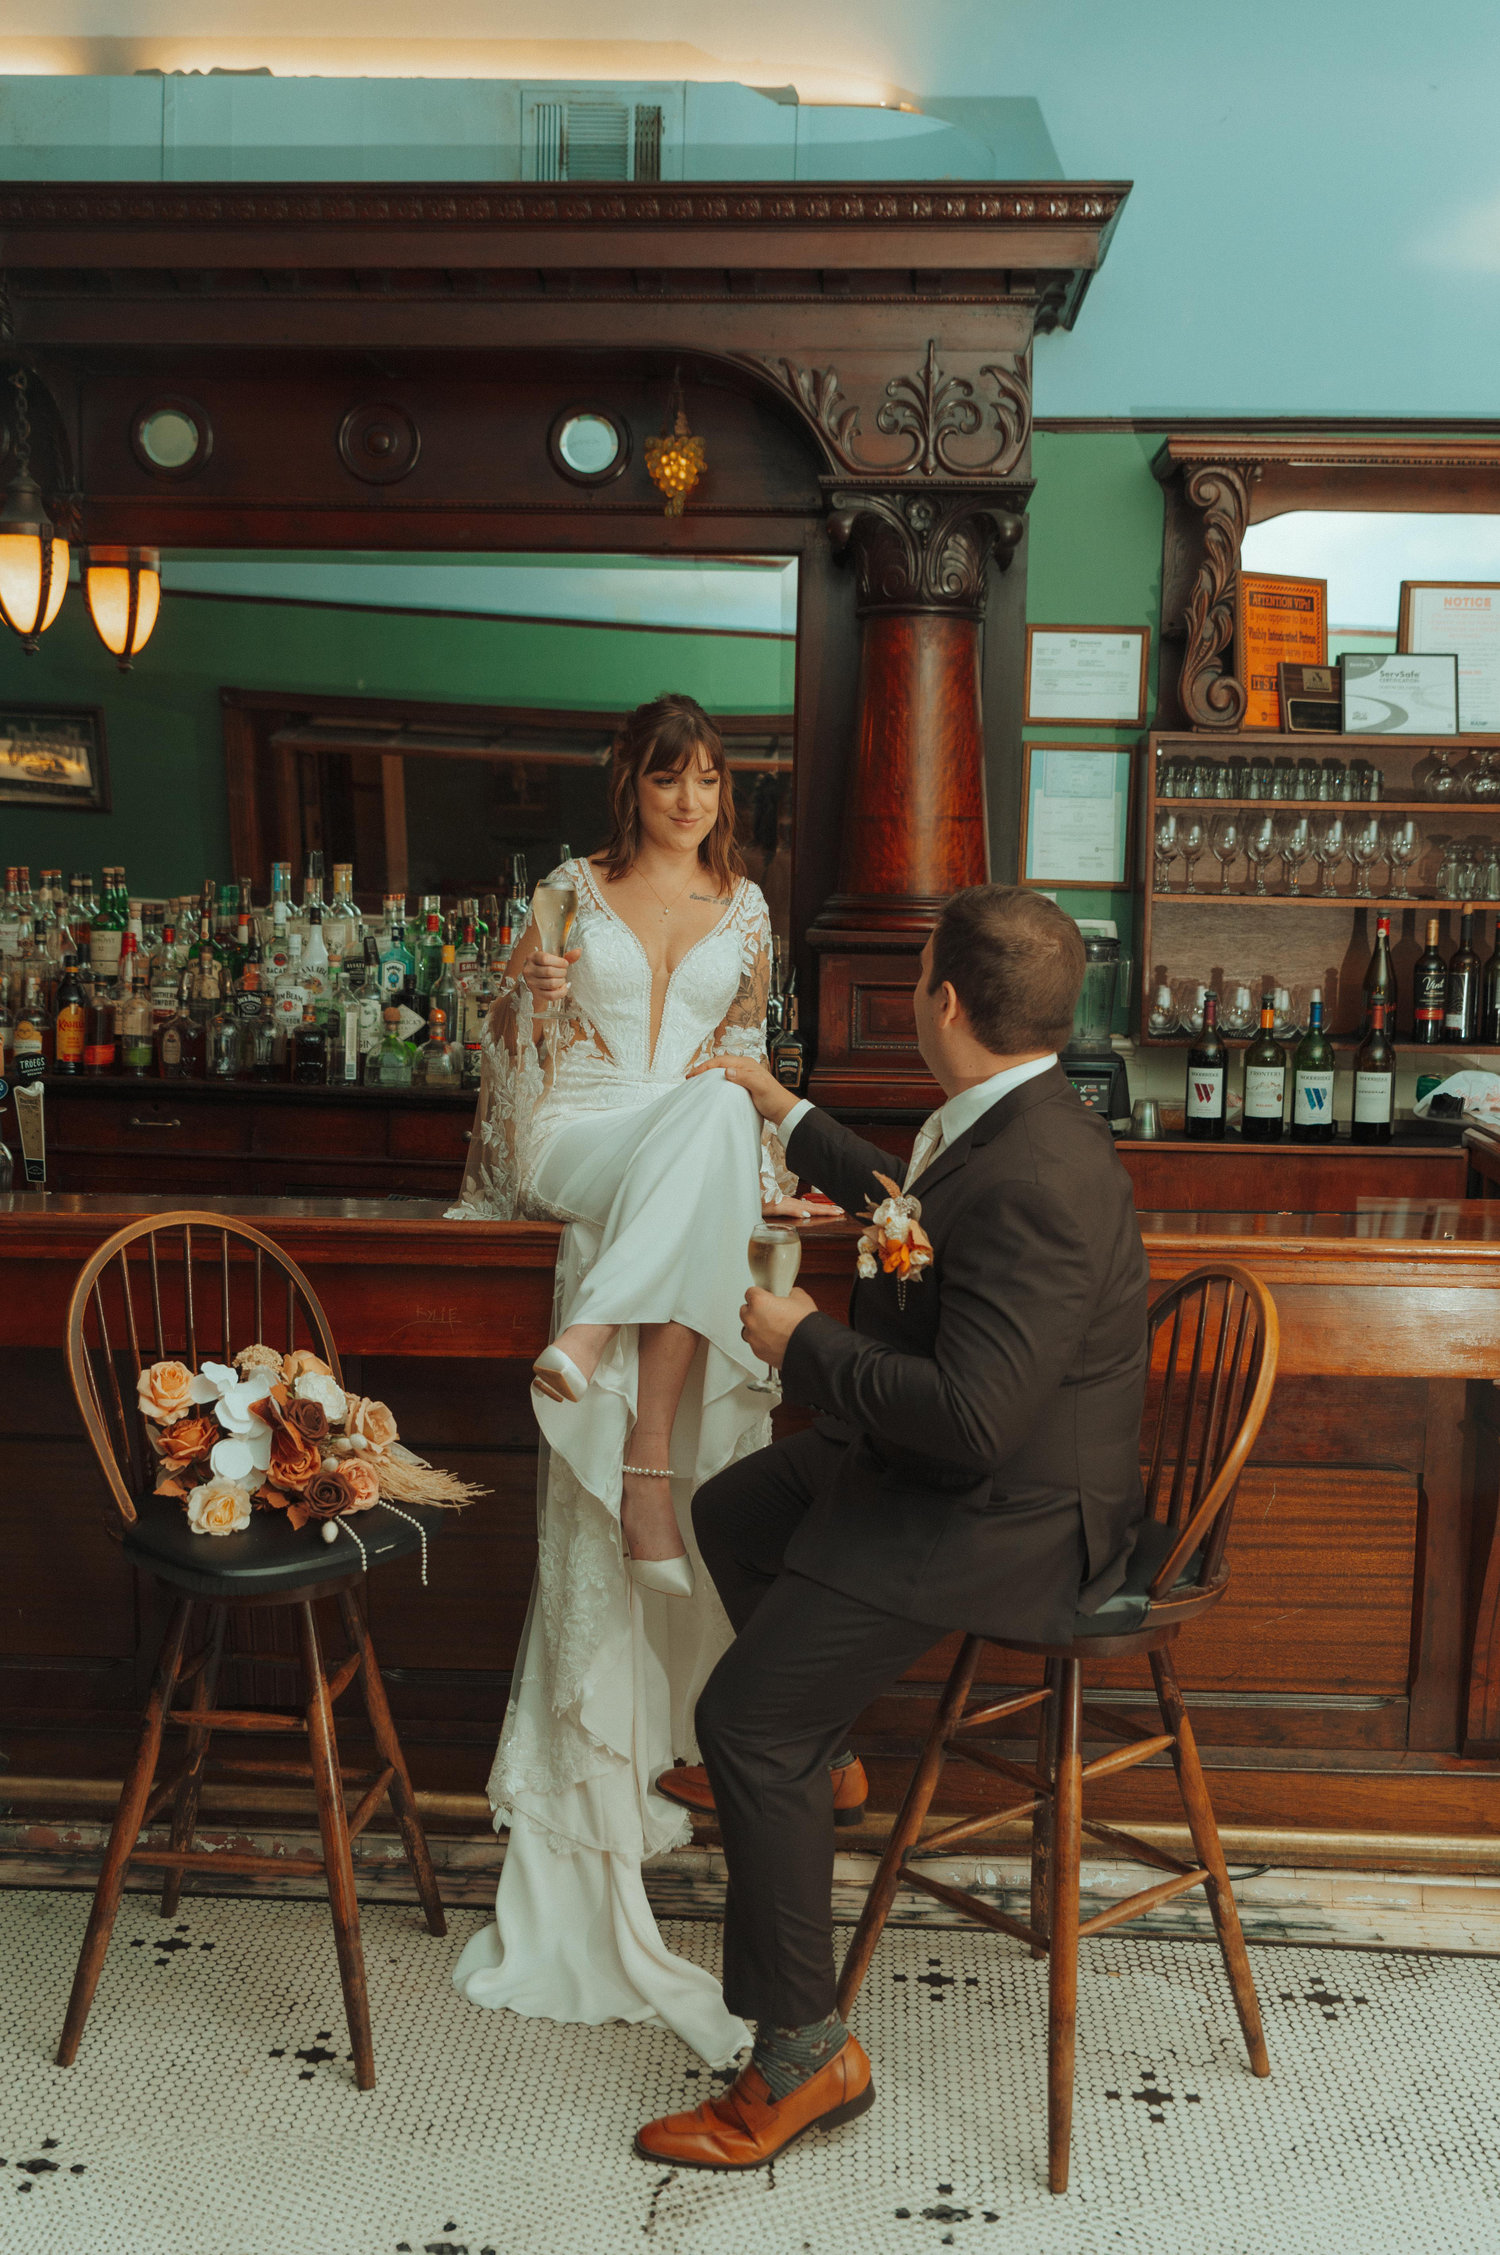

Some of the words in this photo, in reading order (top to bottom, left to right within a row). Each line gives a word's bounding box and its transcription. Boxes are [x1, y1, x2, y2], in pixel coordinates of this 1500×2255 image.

[1253, 594, 1292, 608] ATTENTION
[1444, 596, 1491, 608] NOTICE
[1268, 614, 1290, 625] appear
[1268, 628, 1297, 643] Intoxicated
[1379, 670, 1420, 679] ServSafe
[1253, 677, 1269, 689] IT'S
